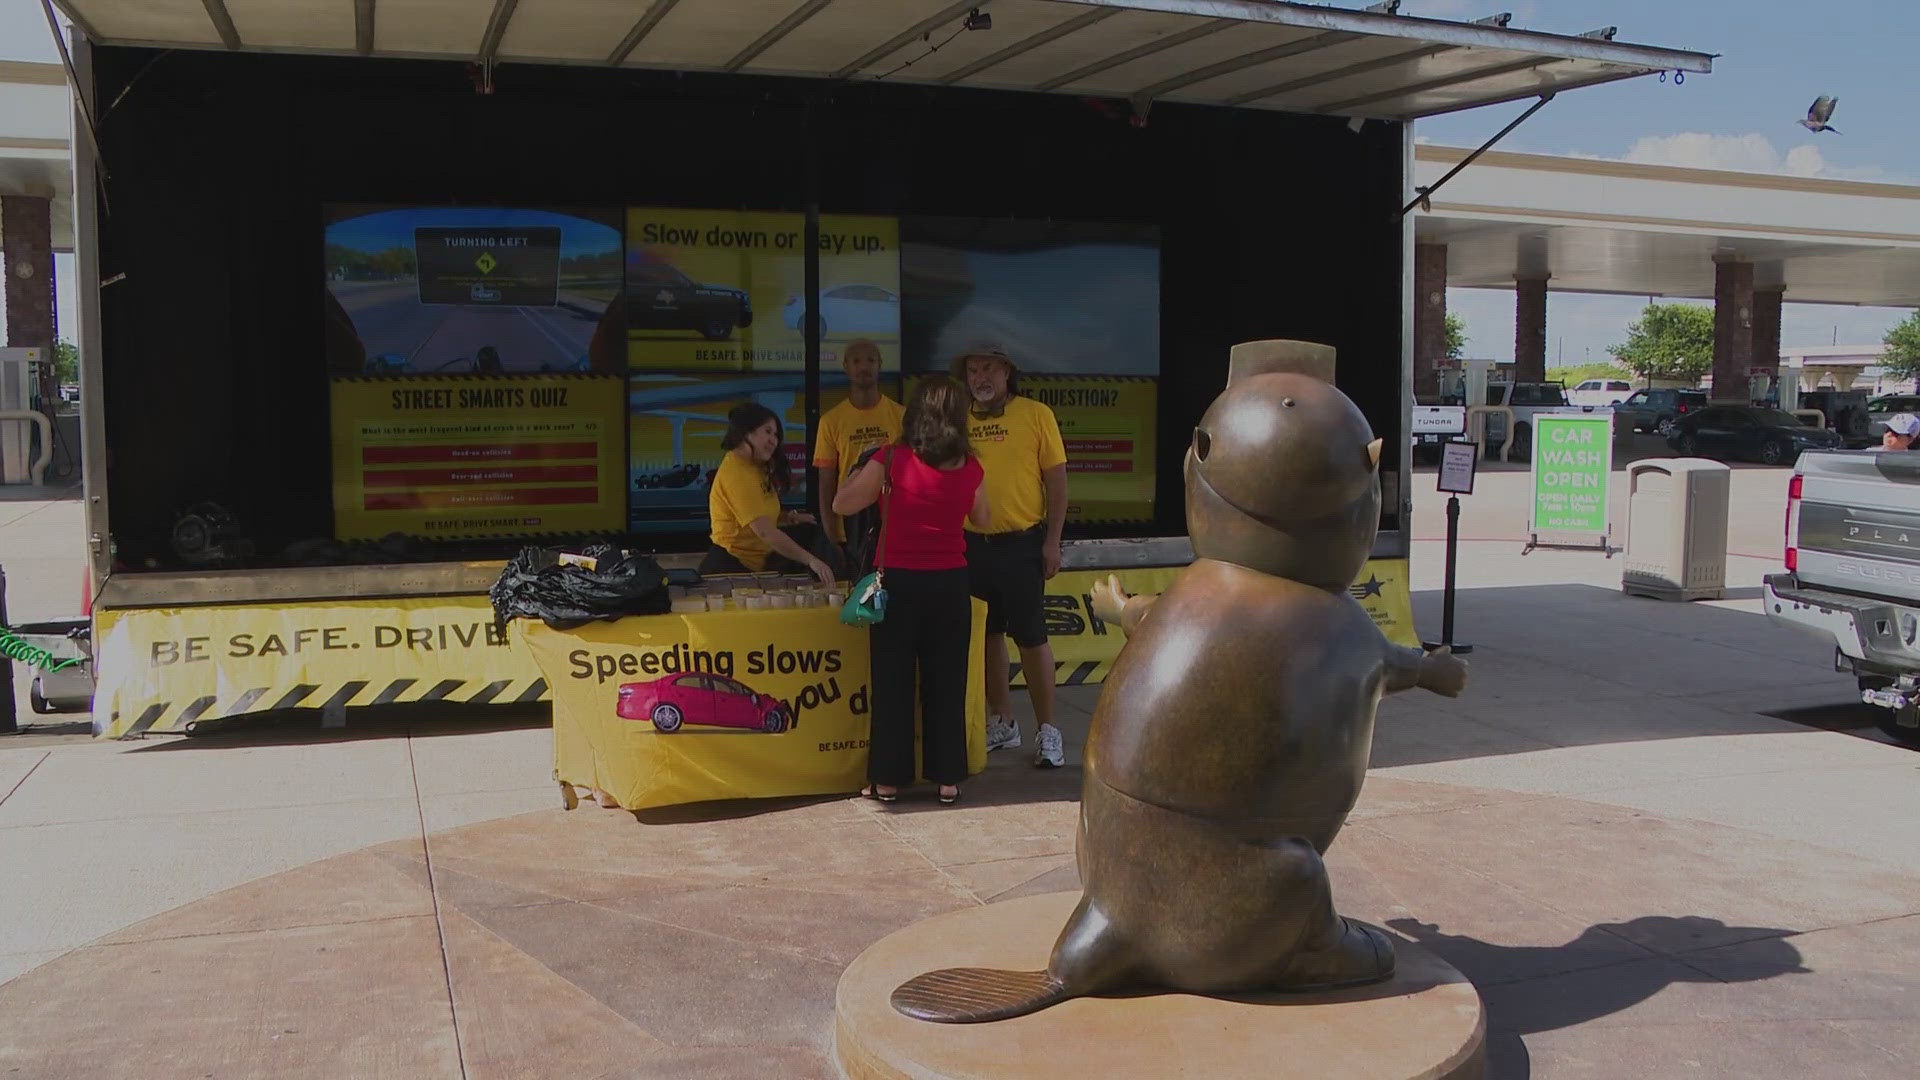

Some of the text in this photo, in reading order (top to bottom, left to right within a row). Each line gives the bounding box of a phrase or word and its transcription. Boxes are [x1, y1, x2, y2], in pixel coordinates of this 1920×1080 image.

[445, 237, 528, 247] TURNING LEFT
[643, 223, 886, 255] Slow down or ay up.
[695, 350, 803, 361] BE SAFE. DRIVE SMAR
[392, 386, 568, 411] STREET SMARTS QUIZ
[1039, 388, 1119, 407] QUESTION?
[1551, 428, 1593, 445] CAR
[1542, 450, 1601, 467] WASH
[1543, 471, 1598, 488] OPEN
[1538, 493, 1600, 503] OPEN DAILY
[424, 520, 435, 530] BE
[463, 519, 487, 529] DRIVE
[1548, 518, 1589, 527] NO CASH
[1849, 526, 1909, 542] PLA
[151, 622, 510, 668] BE SAFE. DRIVE
[569, 643, 841, 685] Speeding slows
[785, 677, 842, 729] you
[818, 742, 831, 752] BE
[832, 740, 857, 751] SAFE.
